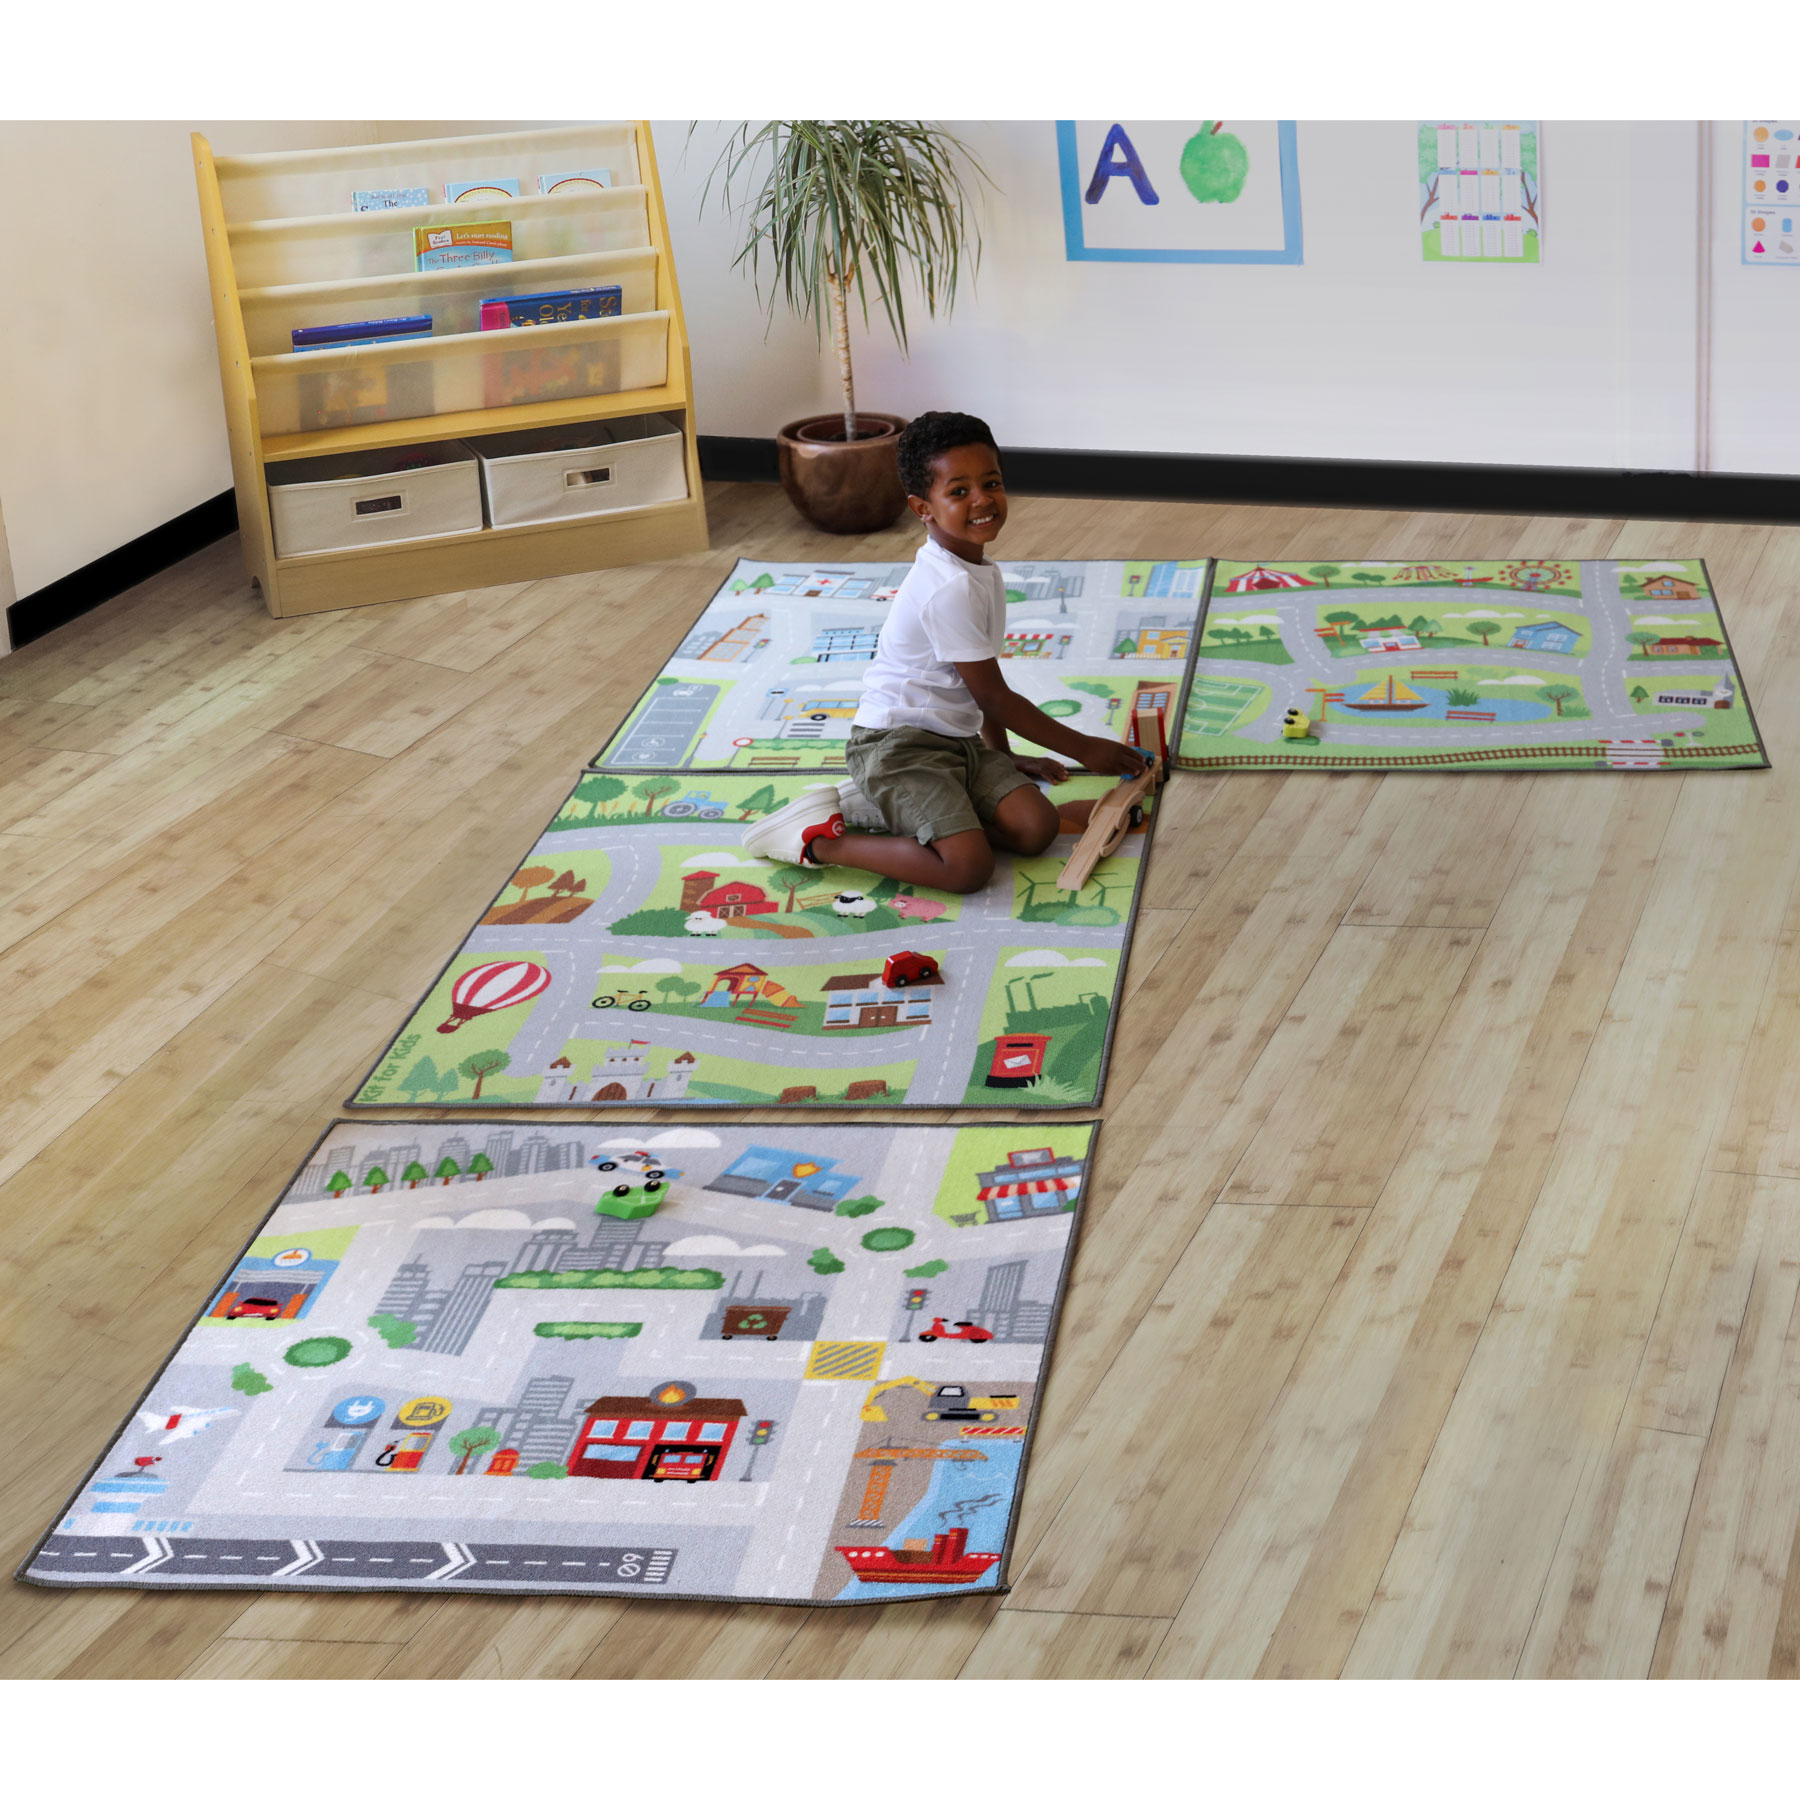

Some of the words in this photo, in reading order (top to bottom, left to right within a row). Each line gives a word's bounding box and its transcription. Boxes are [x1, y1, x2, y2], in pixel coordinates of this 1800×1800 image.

[1085, 123, 1160, 205] A
[439, 252, 470, 263] Three
[472, 249, 495, 261] Billy
[357, 1085, 386, 1102] Kit
[373, 1063, 401, 1081] for
[388, 1034, 421, 1059] Kids
